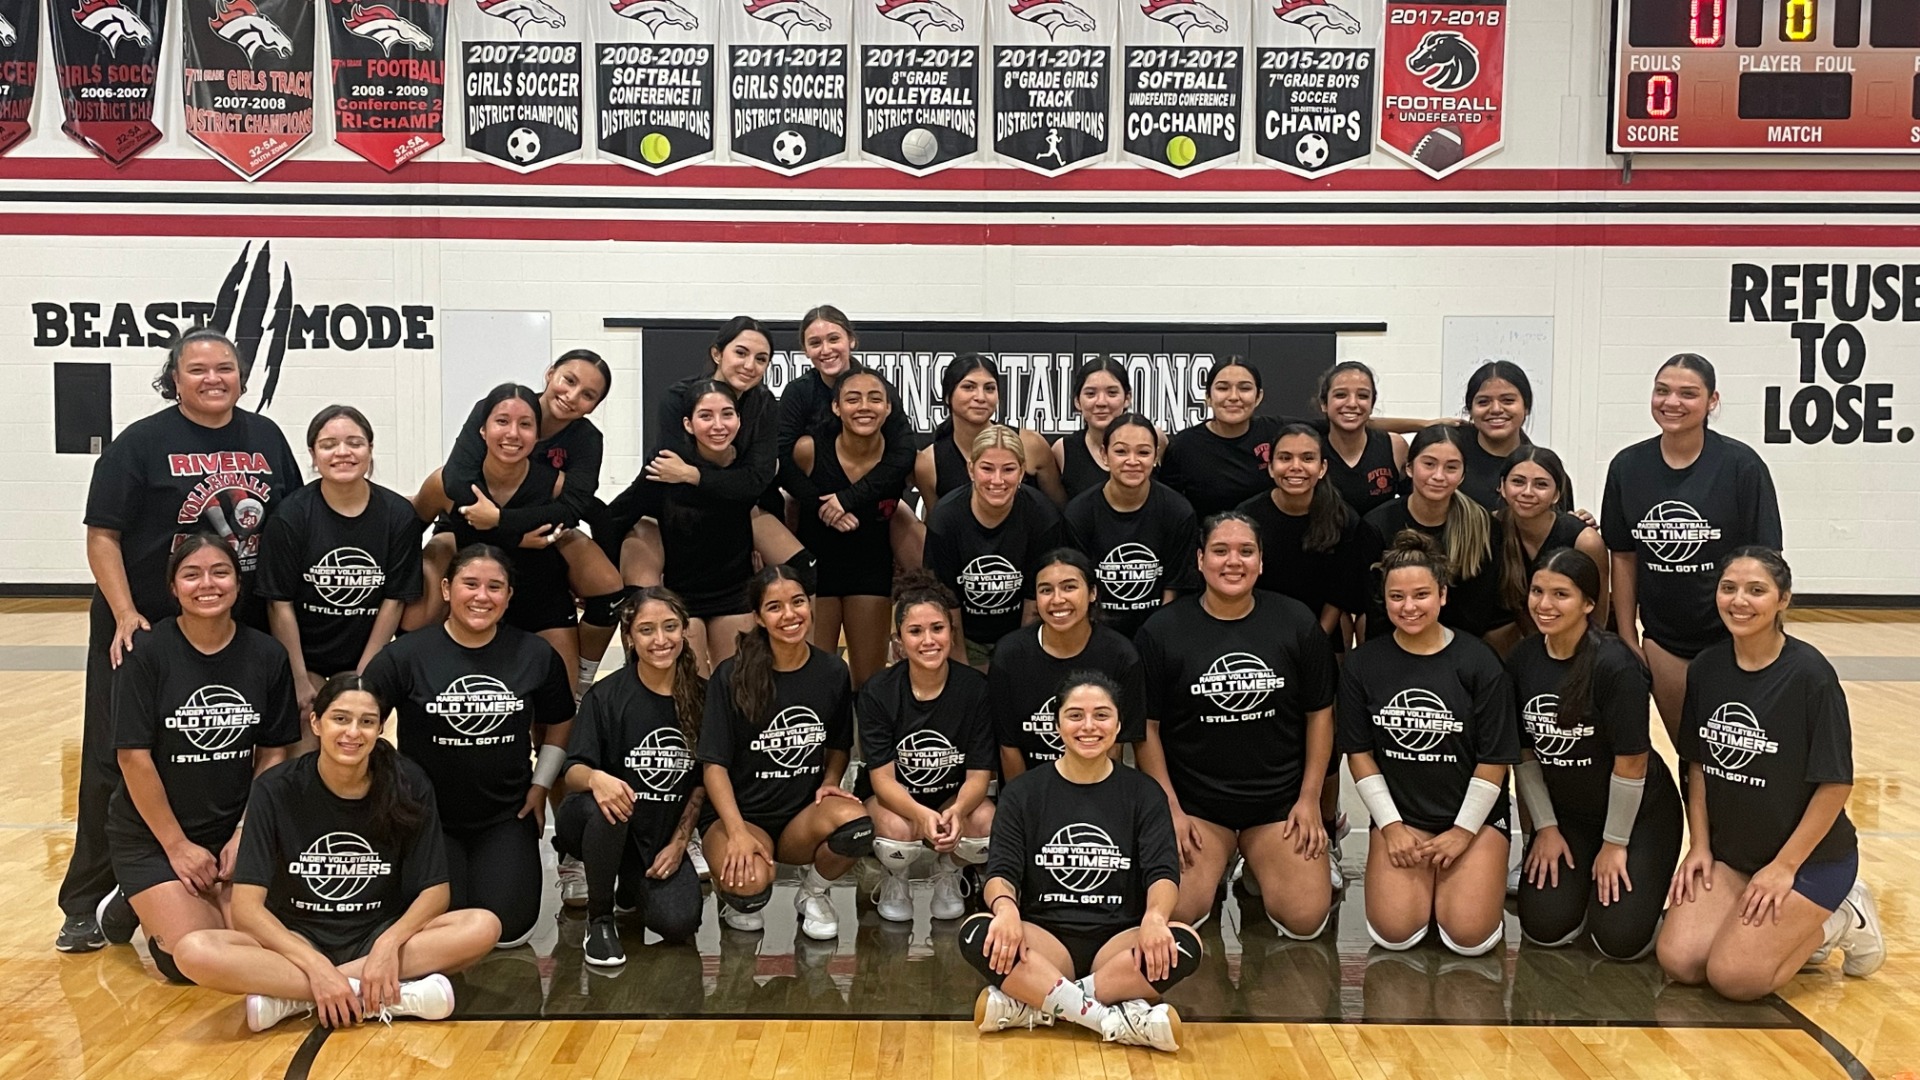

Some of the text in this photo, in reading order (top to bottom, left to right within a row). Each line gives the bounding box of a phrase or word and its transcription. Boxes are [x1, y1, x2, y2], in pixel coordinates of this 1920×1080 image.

[1390, 9, 1500, 26] 2017-2018
[467, 45, 576, 64] 2007-2008
[600, 47, 710, 66] 2008-2009
[733, 49, 843, 68] 2011-2012
[865, 49, 974, 68] 2011-2012
[997, 49, 1106, 68] 2011-2012
[1129, 50, 1238, 69] 2011-2012
[1260, 51, 1370, 70] 2015-2016
[1630, 55, 1681, 71] FOULS
[1739, 55, 1856, 72] PLAYER FOUL
[227, 70, 267, 91] GIRLS
[270, 71, 313, 100] TRACK
[467, 71, 579, 98] GIRLS SOCCER
[612, 68, 702, 87] SOFTBALL
[907, 71, 948, 85] GRADE
[1019, 71, 1061, 89] GRADE
[1063, 71, 1099, 89] GIRLS
[1137, 71, 1227, 90] SOFTBALL
[1284, 74, 1325, 88] GRADE
[1327, 73, 1360, 88] BOYS
[81, 88, 148, 98] 2006-2007
[351, 85, 429, 96] 2008 2009
[731, 74, 844, 100] GIRLS SOCCER
[1646, 75, 1672, 116] 0
[214, 97, 286, 109] 2007-2008
[336, 98, 442, 111] Conference 2
[609, 87, 702, 105] CONFERENCE II
[865, 87, 973, 106] VOLLEYBALL
[1028, 90, 1073, 108] TRACK
[1128, 93, 1178, 106] UNDEFEATED
[1179, 93, 1228, 107] CONFERENCE
[1290, 91, 1337, 104] SOCCER
[1385, 96, 1497, 111] FOOTBALL
[185, 104, 312, 133] DISTRICT CHAMPIONS
[336, 111, 443, 129] RI-CHAMP
[469, 104, 578, 136] DISTRICT CHAMPIONS
[601, 108, 711, 140] DISTRICT CHAMPIONS
[735, 107, 844, 140] DISTRICT CHAMPIONS
[867, 108, 975, 139] DISTRICT CHAMPIONS
[1265, 109, 1361, 143] CHAMPS
[1399, 112, 1482, 123] UNDEFEATED
[997, 111, 1104, 142] DISTRICT CHAMPIONS
[1127, 112, 1235, 142] CO-CHAMPS
[1627, 125, 1679, 142] SCORE
[1767, 126, 1822, 143] MATCH
[248, 138, 278, 158] 32-5A
[393, 135, 424, 158] 32-5A
[1729, 263, 1920, 322] REFUSE
[31, 302, 435, 350] BEAST MODE
[1791, 322, 1866, 385] TO
[1764, 384, 1914, 444] LOSE.
[168, 451, 272, 476] RIVERA
[178, 472, 271, 524] VOLLEYBALL
[1631, 529, 1721, 540] OLD TIMERS
[1701, 562, 1714, 571] IT!
[303, 573, 331, 585] OLD
[978, 578, 1023, 590] TIMER
[309, 605, 366, 616] STILL GOT
[1131, 602, 1150, 610] GOT
[1191, 677, 1285, 695] OLD TIMERS
[1199, 672, 1276, 683] RAIDER VOLLEYBALL
[206, 707, 254, 715] VOLLEYBALL
[426, 700, 524, 713] OLD TIMERS
[165, 713, 261, 728] OLD TIMERS
[1206, 712, 1262, 723] STILL GOT
[1372, 715, 1463, 732] OLD TIMERS
[1407, 710, 1455, 721] VOLLEYBALL
[1023, 722, 1053, 731] OLD
[1722, 725, 1768, 740] VOLLEYBALL
[439, 737, 500, 746] STILL GOT
[750, 731, 826, 750] OLD TIMERS
[1699, 726, 1778, 753] OLD TIMERS
[176, 751, 237, 763] STILL GOT
[624, 757, 651, 768] OLD
[911, 754, 966, 767] TIMERS
[1386, 749, 1441, 762] STILL GOT
[761, 771, 791, 779] STILL
[1726, 772, 1766, 787] GOT IT!
[328, 855, 382, 863] VOLLEYBALL
[1070, 848, 1122, 856] VOLLEYBALL
[289, 862, 391, 875] OLD TIMERS
[1035, 854, 1131, 870] OLD TIMERS
[296, 901, 381, 912] STILL GOT IT!
[1044, 894, 1122, 904] STILL GOT IT!
